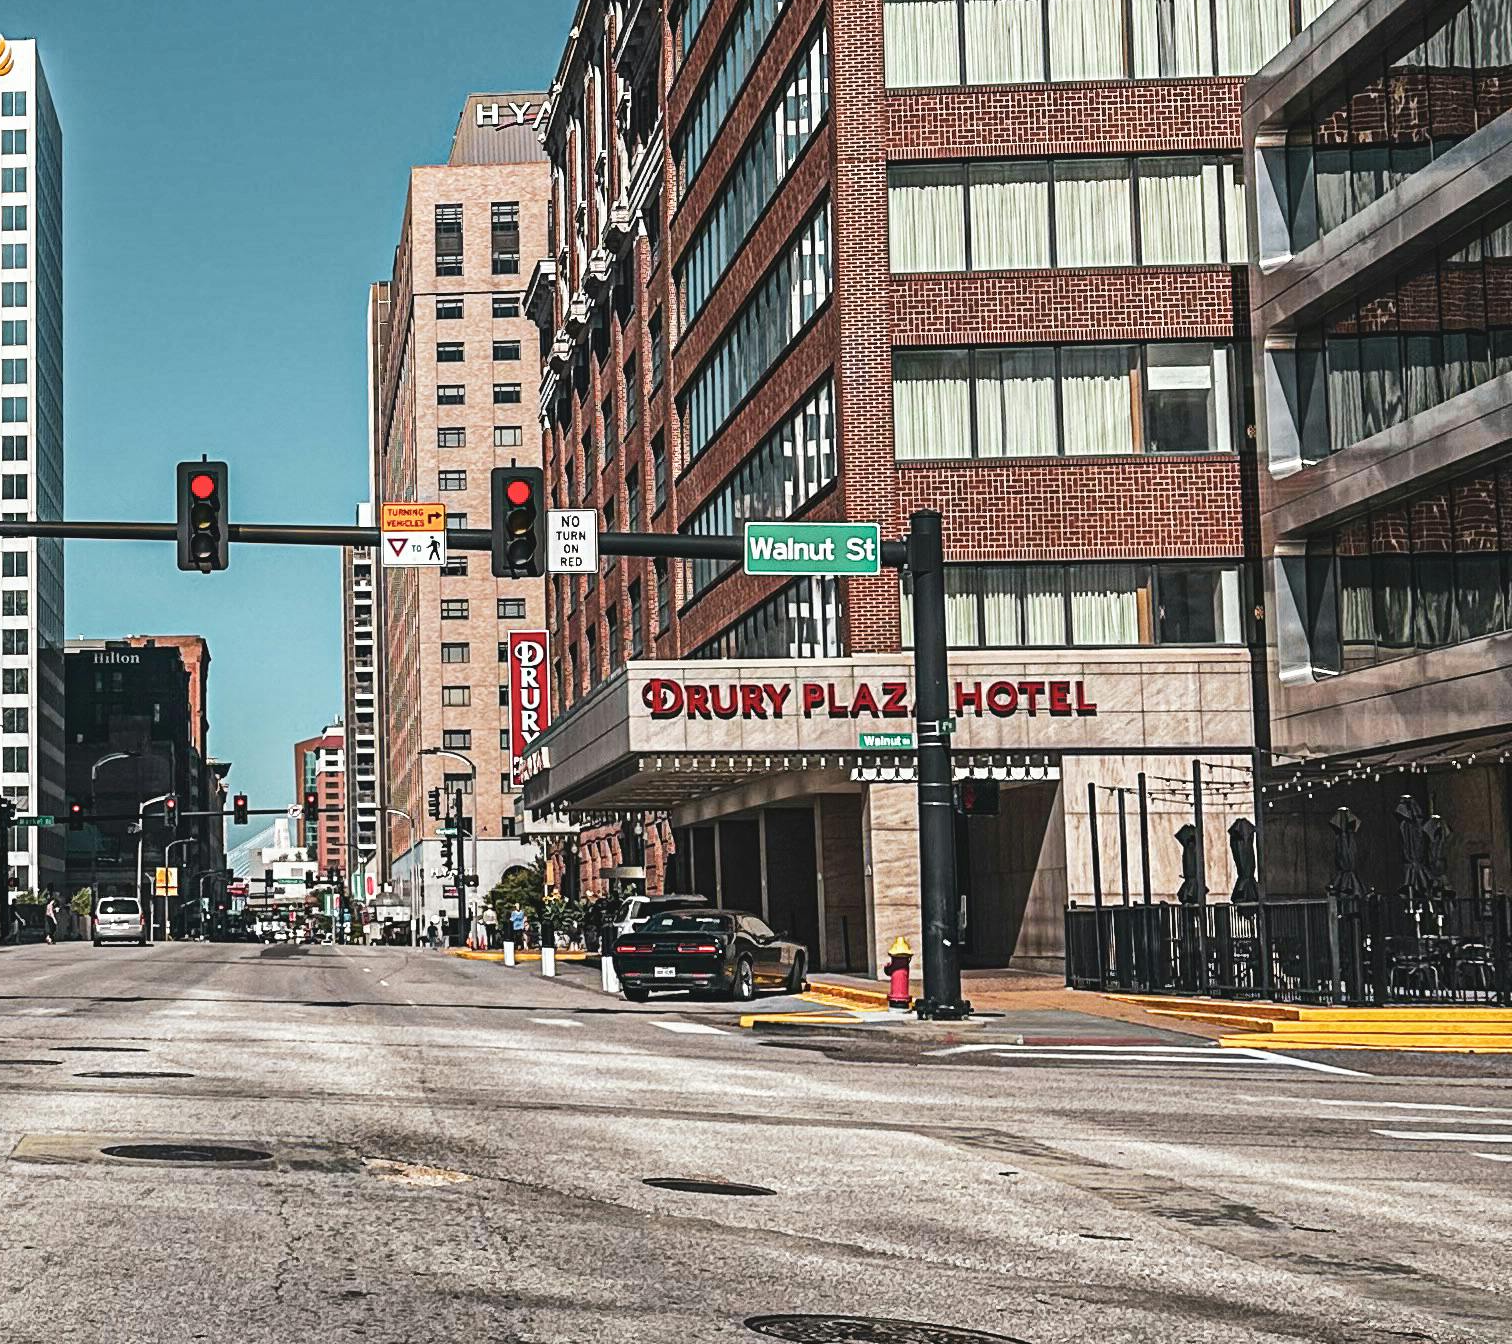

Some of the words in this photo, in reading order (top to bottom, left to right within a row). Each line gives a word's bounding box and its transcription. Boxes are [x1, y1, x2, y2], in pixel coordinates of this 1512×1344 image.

[387, 508, 424, 516] TURNING
[386, 519, 425, 527] VEHICLES
[561, 515, 580, 527] NO
[556, 531, 586, 541] TURN
[563, 544, 579, 554] ON
[749, 536, 835, 561] Walnut
[846, 537, 876, 561] St
[560, 557, 583, 567] RED
[93, 651, 140, 664] Hilton
[514, 641, 544, 745] DRURY
[642, 678, 791, 720] DRURY
[802, 682, 917, 719] PLAZ
[954, 680, 1098, 718] HOTEL
[863, 735, 902, 746] Walnut
